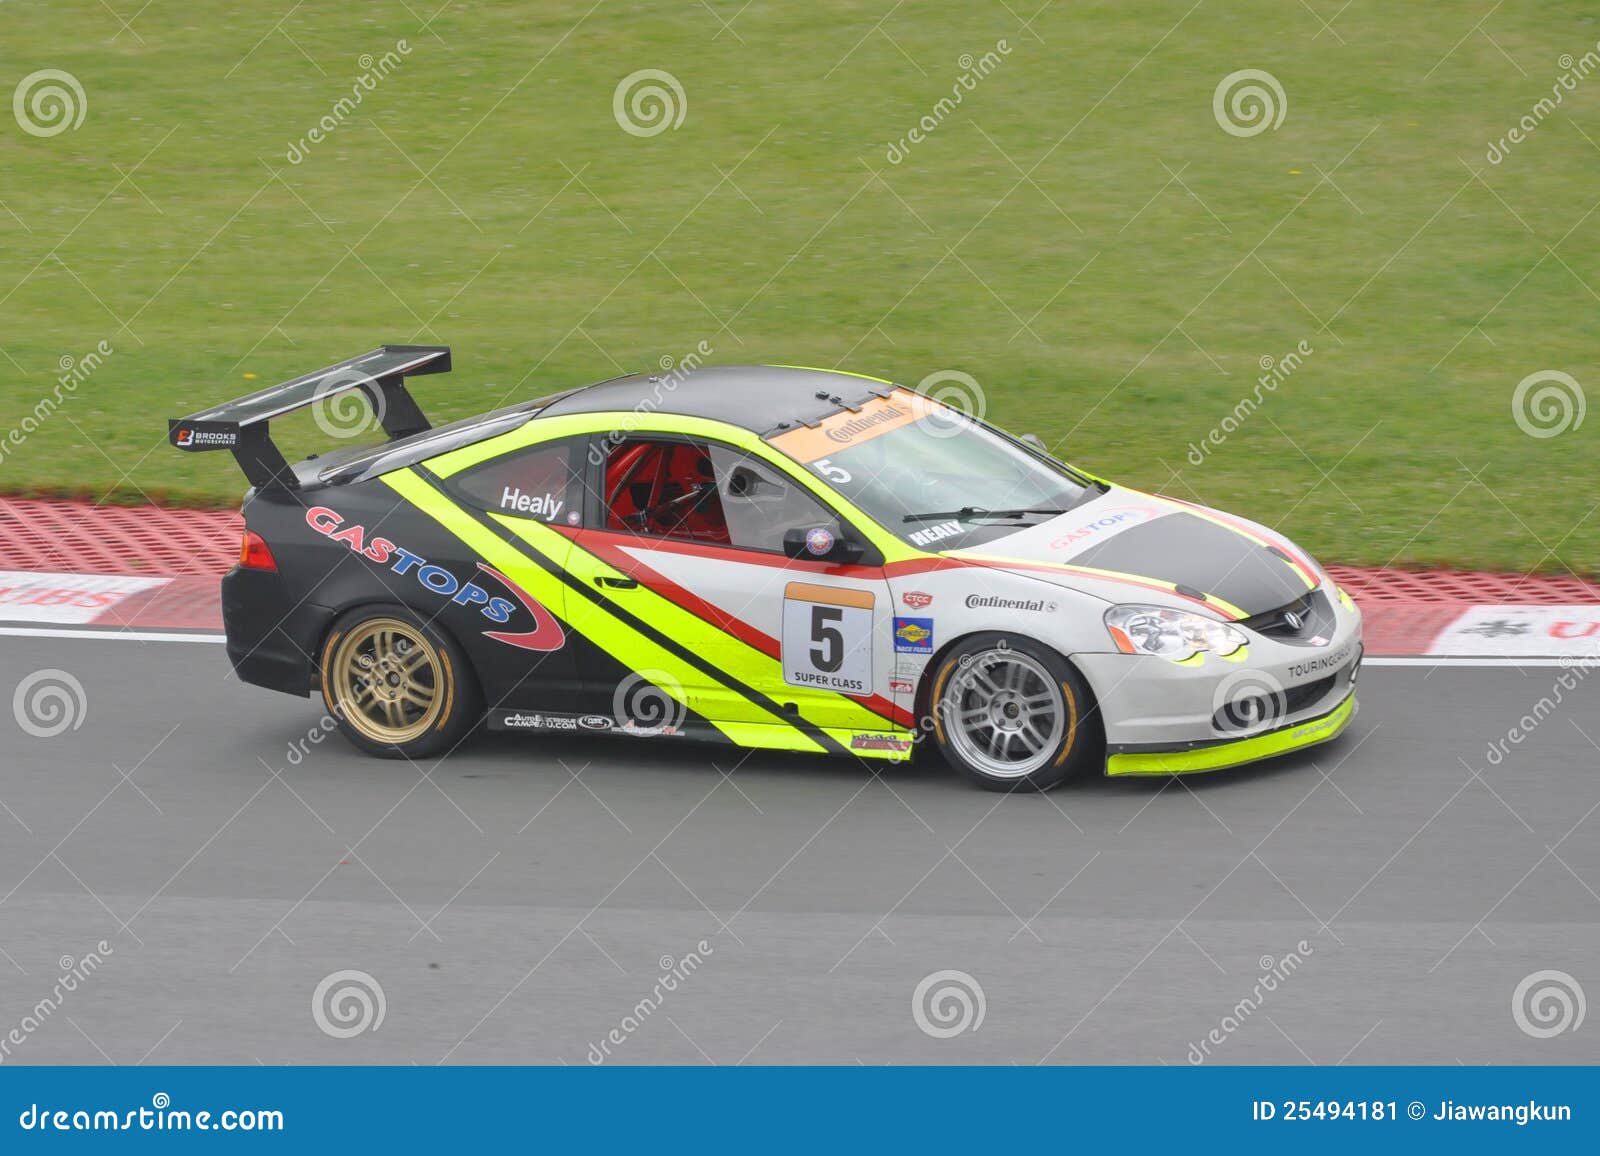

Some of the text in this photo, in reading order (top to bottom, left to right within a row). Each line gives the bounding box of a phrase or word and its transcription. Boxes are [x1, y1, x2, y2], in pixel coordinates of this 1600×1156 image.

[195, 432, 237, 440] BROOKS
[825, 405, 904, 443] Continental
[814, 459, 852, 483] 5
[501, 486, 563, 521] Healy
[909, 520, 964, 546] HEALY
[305, 506, 516, 622] GASTOPS
[905, 595, 929, 604] CTCC
[965, 593, 1044, 612] Continental
[810, 605, 844, 673] 5
[795, 672, 862, 690] SUPER CLASS
